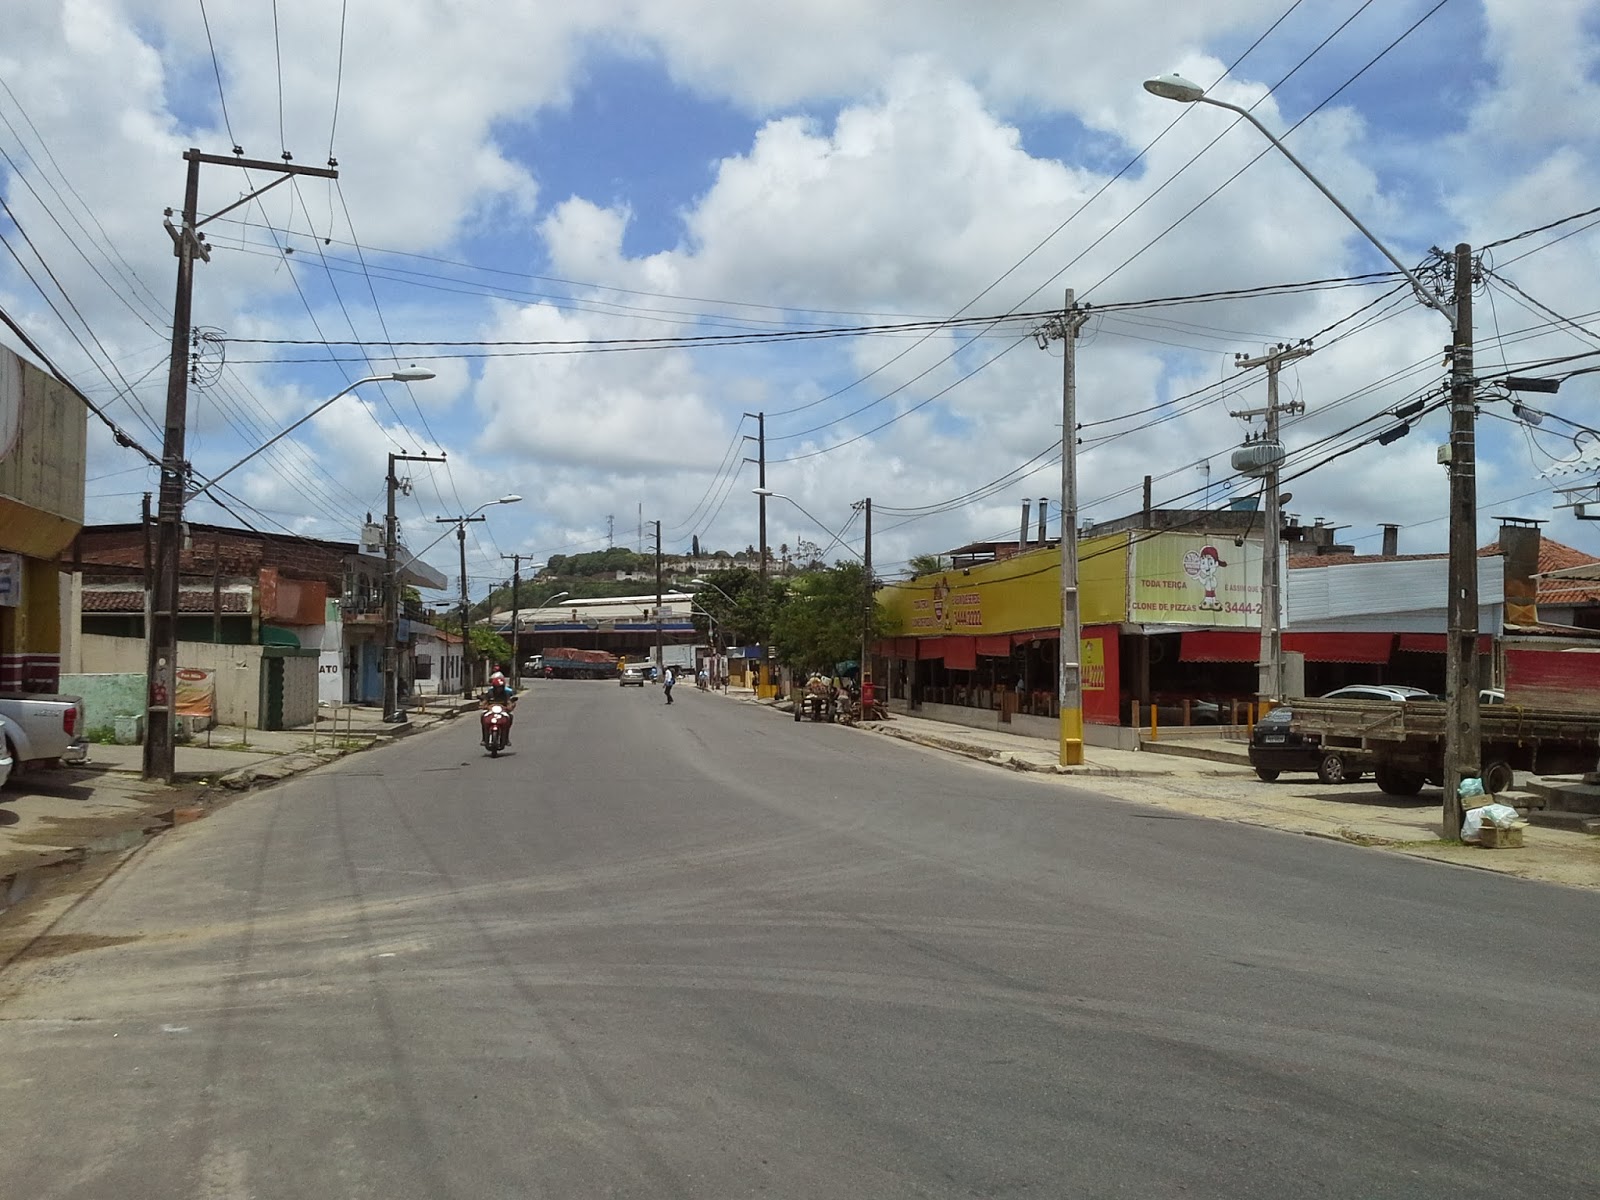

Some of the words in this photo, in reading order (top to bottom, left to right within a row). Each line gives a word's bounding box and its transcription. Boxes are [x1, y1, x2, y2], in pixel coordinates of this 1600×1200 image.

[1141, 579, 1160, 588] TODA
[1162, 580, 1187, 590] TERÇA
[1248, 585, 1258, 593] QUE
[1132, 602, 1157, 611] CLONE
[1159, 603, 1168, 611] DE
[1170, 603, 1196, 612] PIZZAS
[1225, 601, 1283, 615] 3444-22
